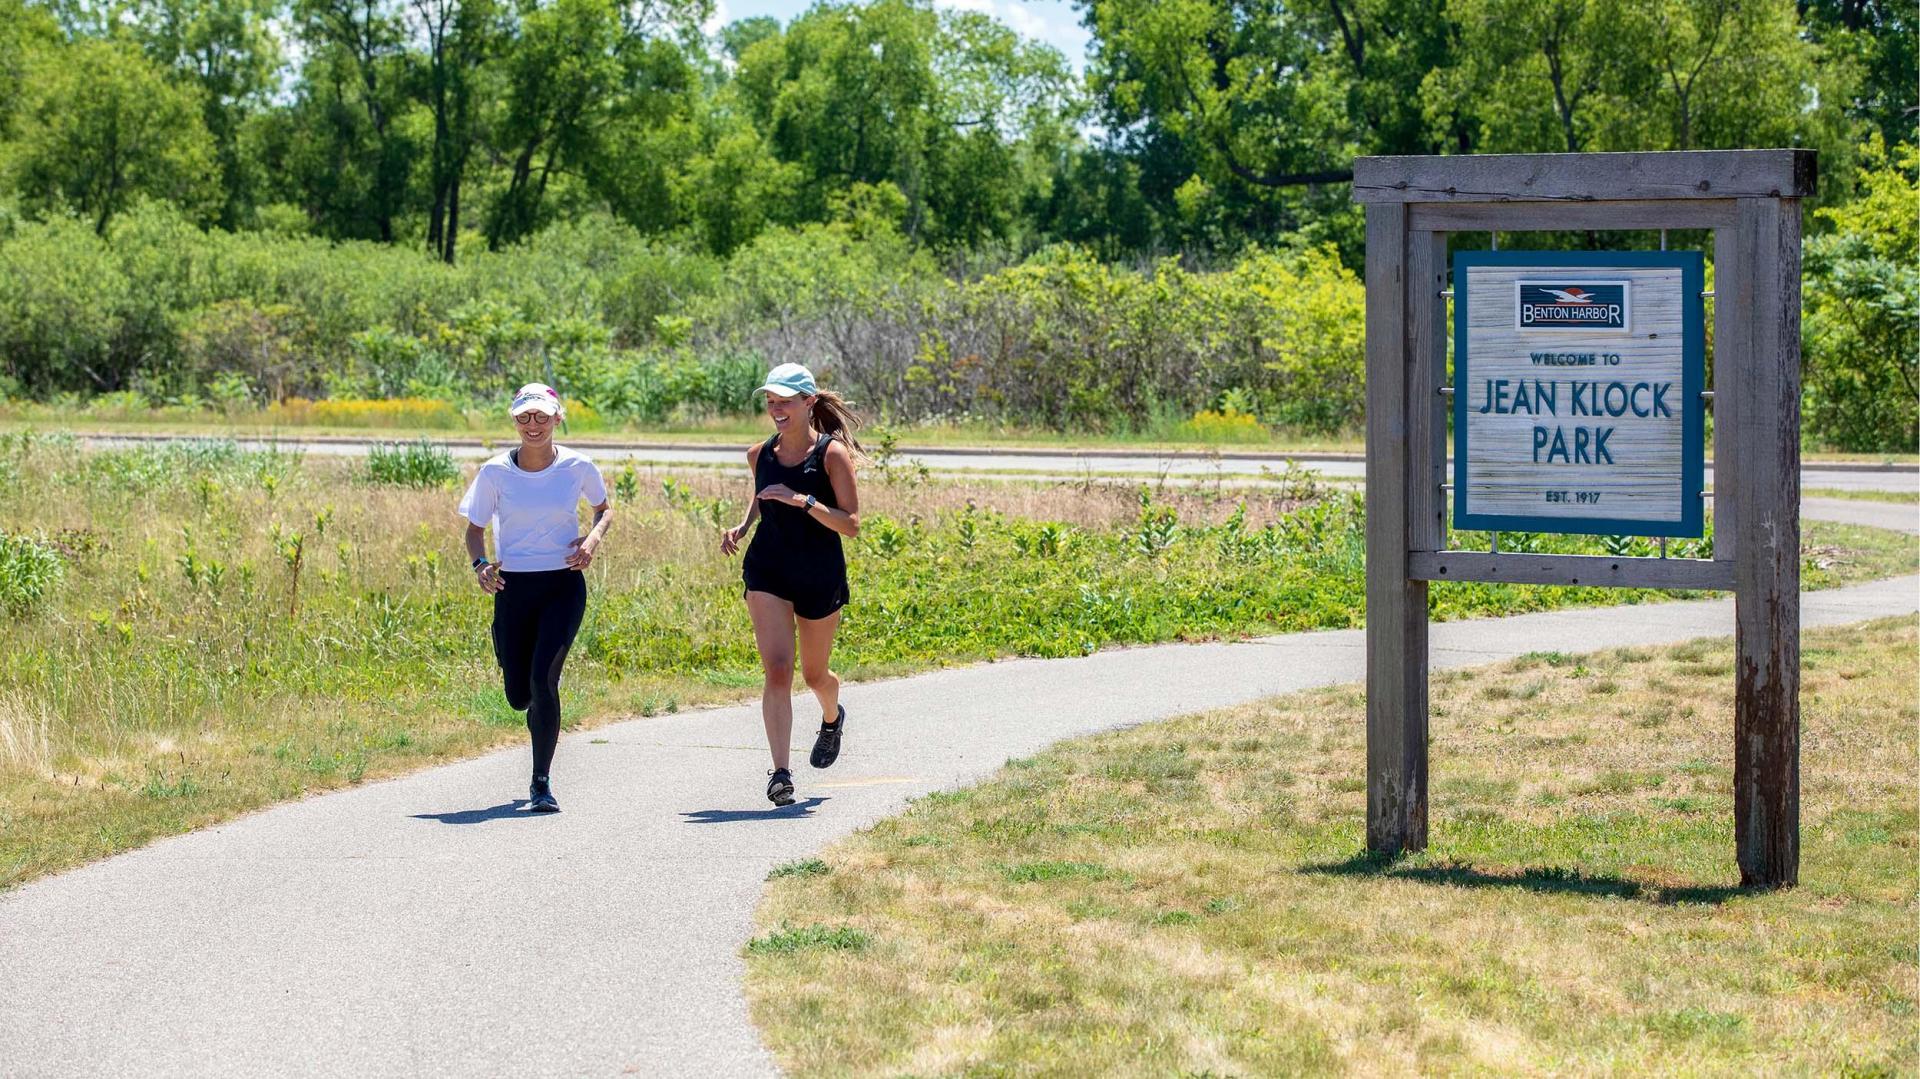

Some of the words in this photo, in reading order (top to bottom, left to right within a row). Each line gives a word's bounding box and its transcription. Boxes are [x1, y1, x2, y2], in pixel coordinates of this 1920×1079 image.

[1523, 304, 1569, 324] BENTON
[1571, 304, 1621, 324] HARBOR
[1530, 352, 1596, 366] WELCOME
[1602, 354, 1620, 366] TO
[1480, 379, 1556, 416] JEAN
[1571, 381, 1672, 418] KLOCK
[1533, 425, 1615, 464] PARK
[1546, 491, 1571, 503] EST.
[1575, 492, 1601, 504] 1917
